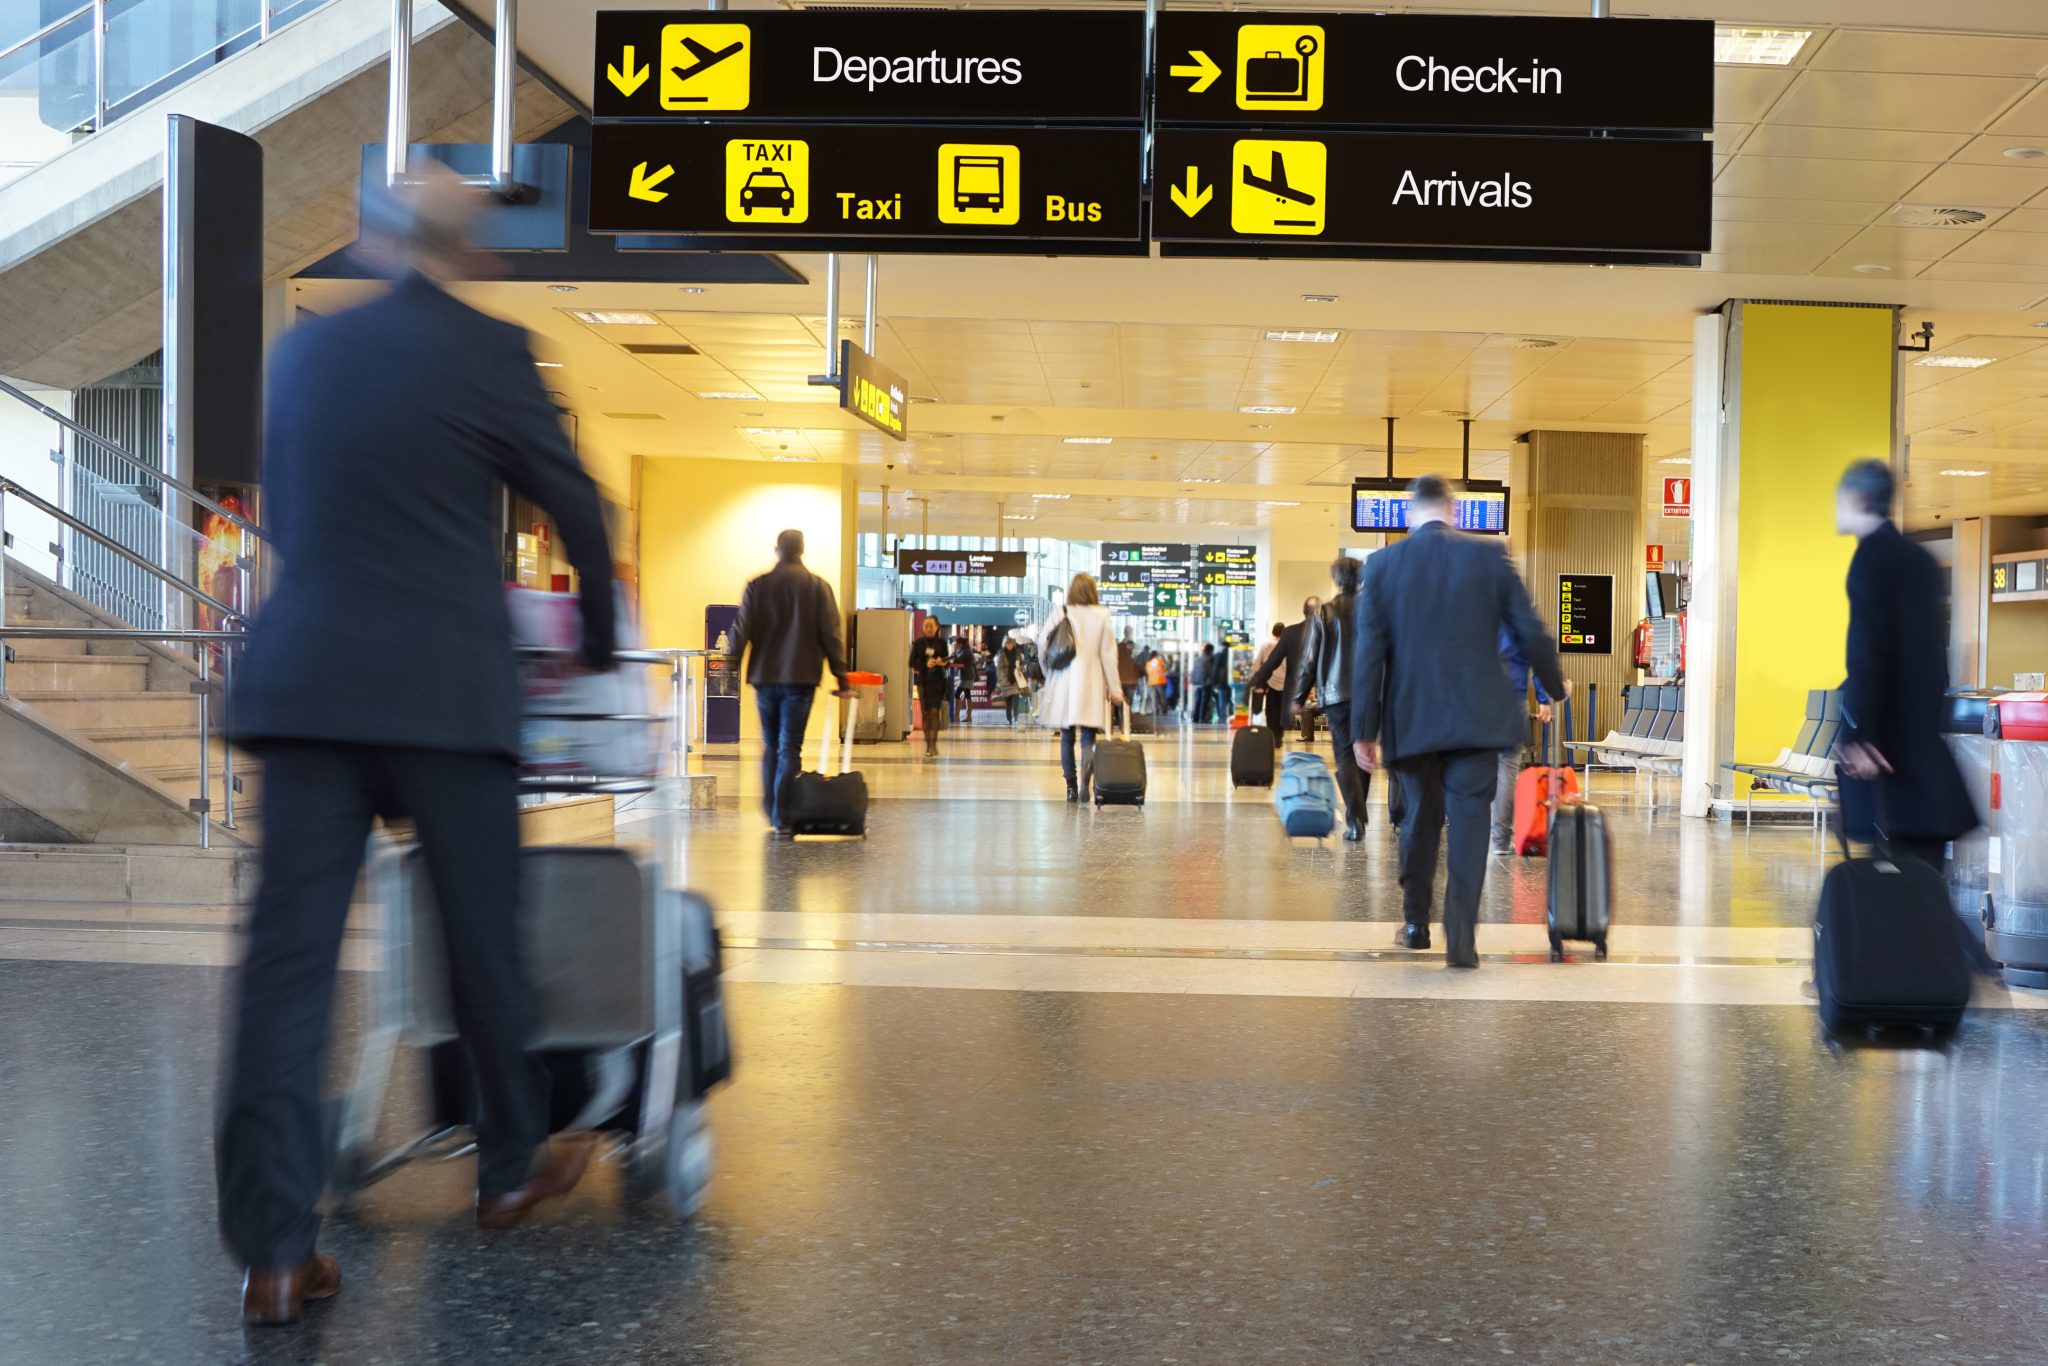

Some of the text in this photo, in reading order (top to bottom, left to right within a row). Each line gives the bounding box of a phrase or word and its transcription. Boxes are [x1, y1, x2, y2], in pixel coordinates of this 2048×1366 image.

[813, 47, 1023, 92] Departures
[1395, 55, 1562, 94] Check-in
[743, 144, 792, 162] TAXI
[1391, 170, 1533, 209] Arrivals
[837, 193, 901, 219] Taxi
[1046, 195, 1102, 222] Bus
[1994, 568, 2006, 588] 38
